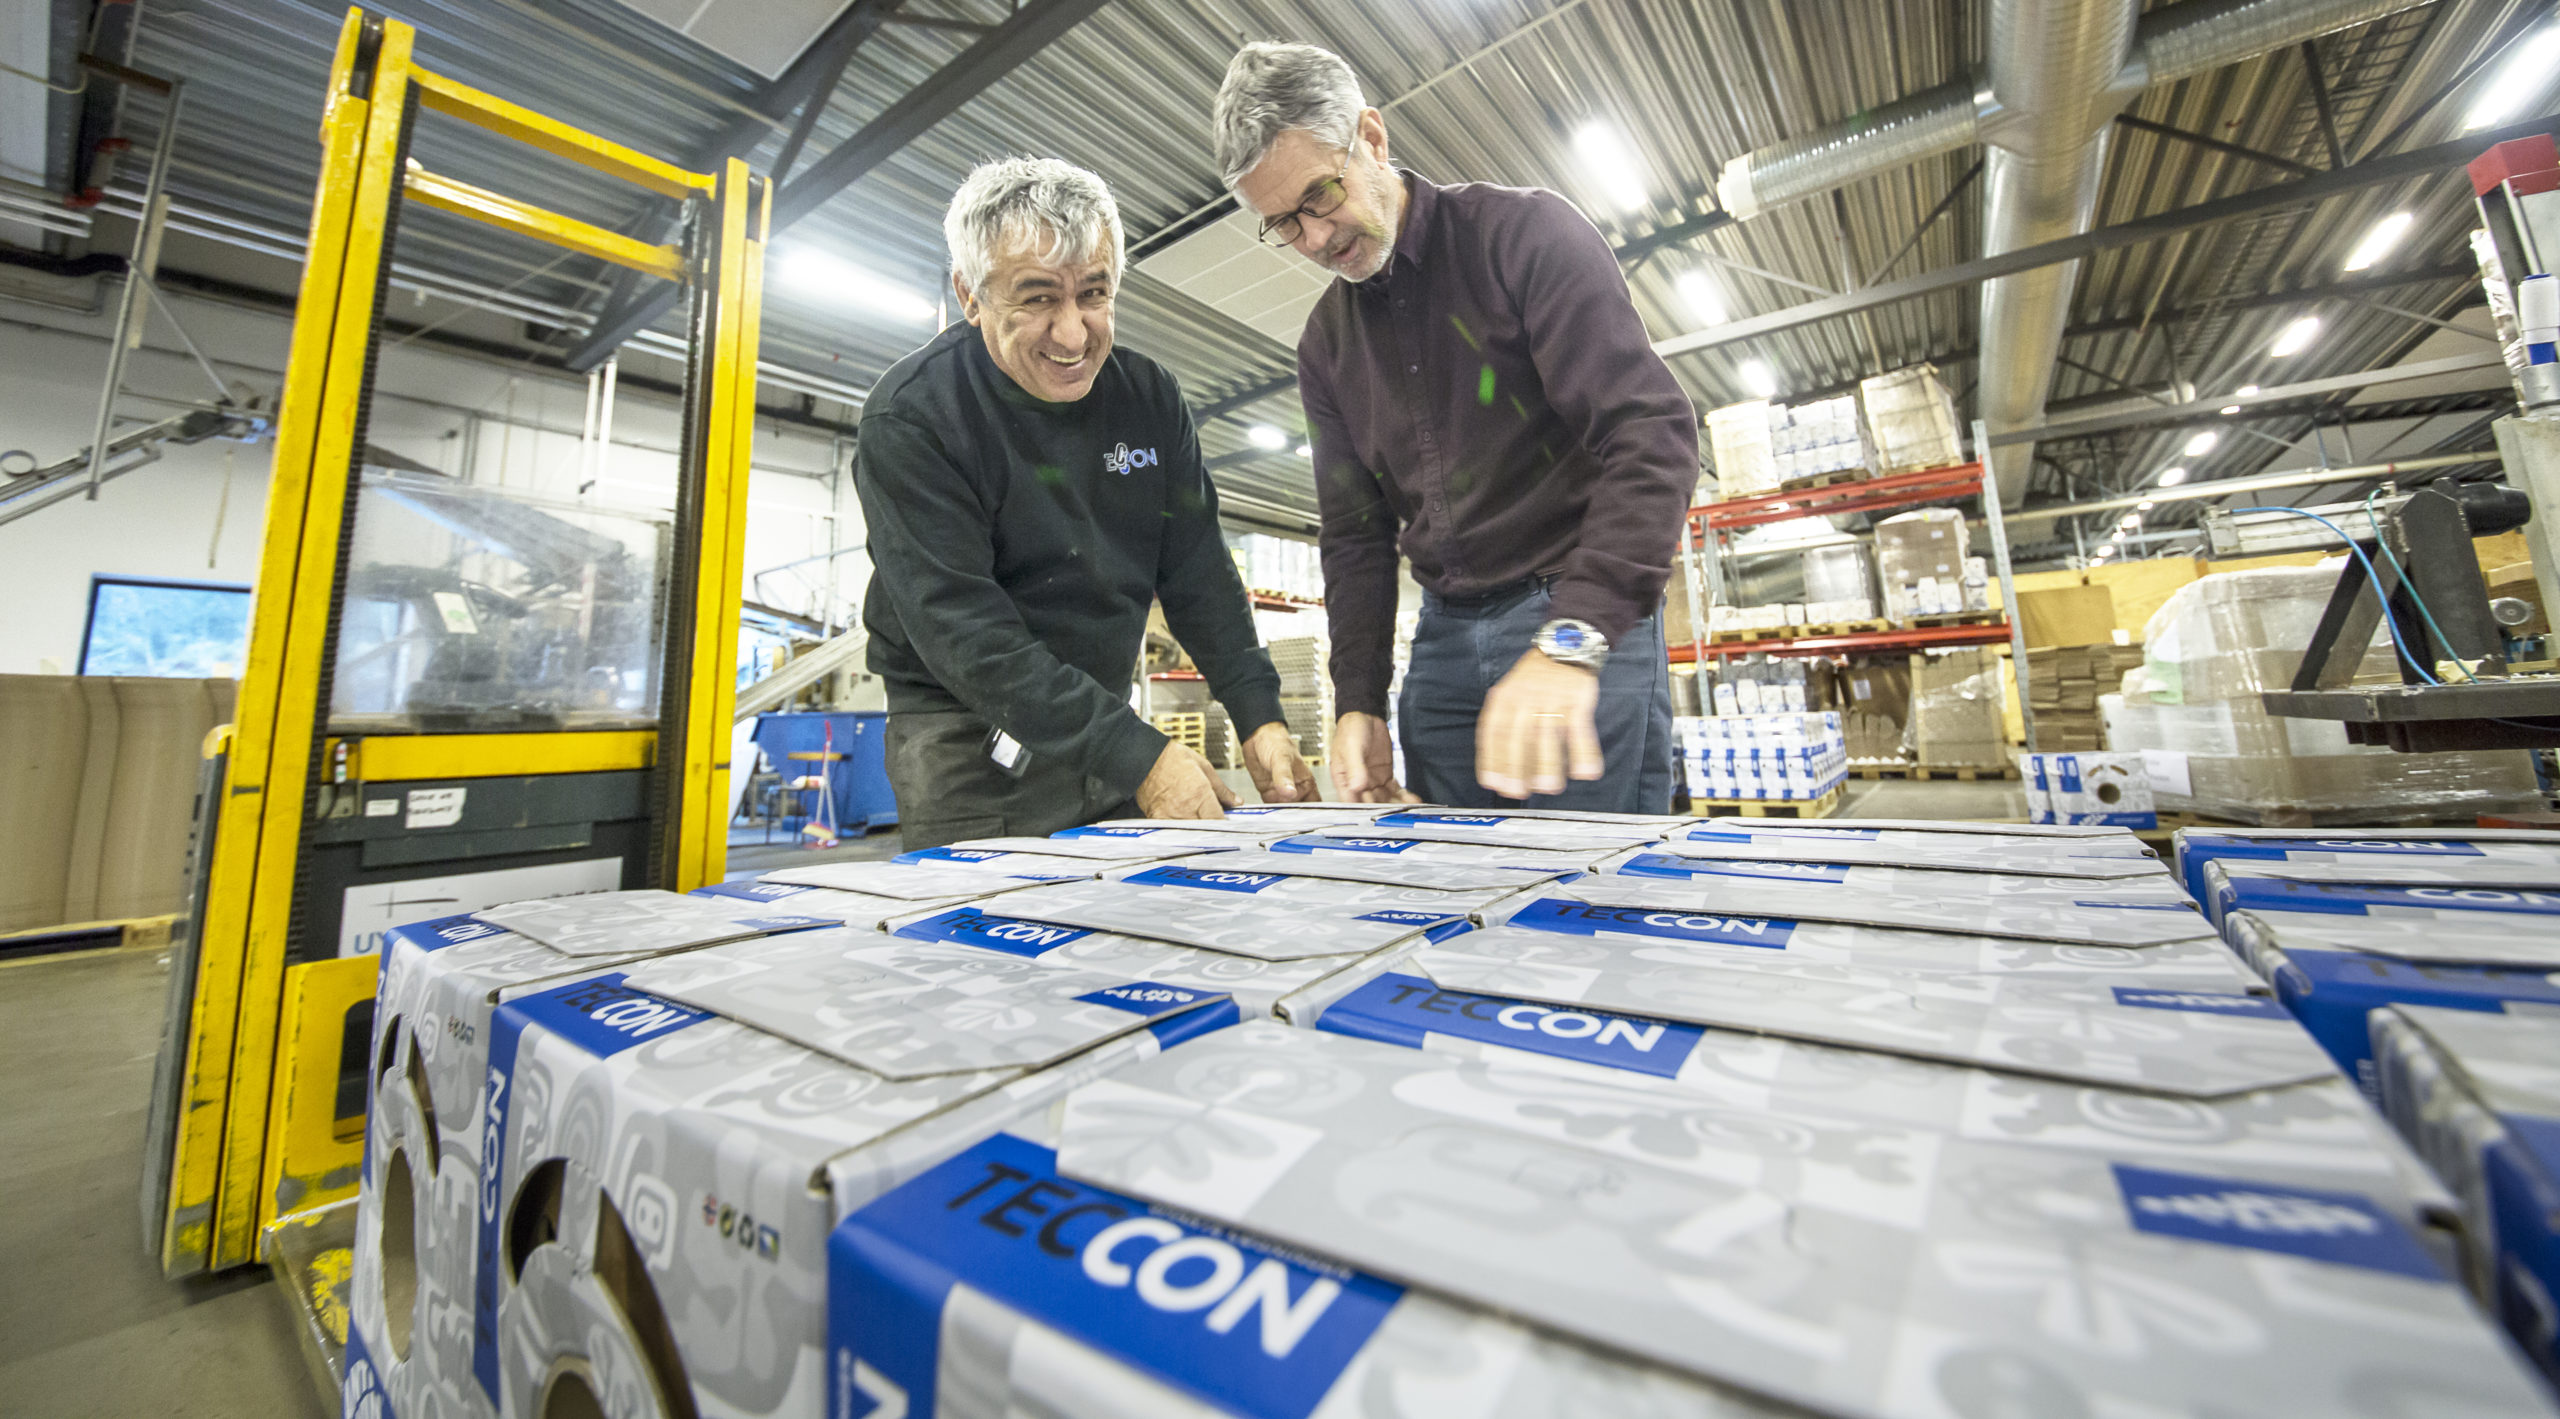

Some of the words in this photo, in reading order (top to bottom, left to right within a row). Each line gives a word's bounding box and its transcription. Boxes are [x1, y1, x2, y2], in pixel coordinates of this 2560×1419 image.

[940, 912, 1072, 946] TECCON
[1556, 904, 1769, 936] TECCON
[1387, 983, 1667, 1052] TECCON
[946, 1160, 1343, 1360] TECCON
